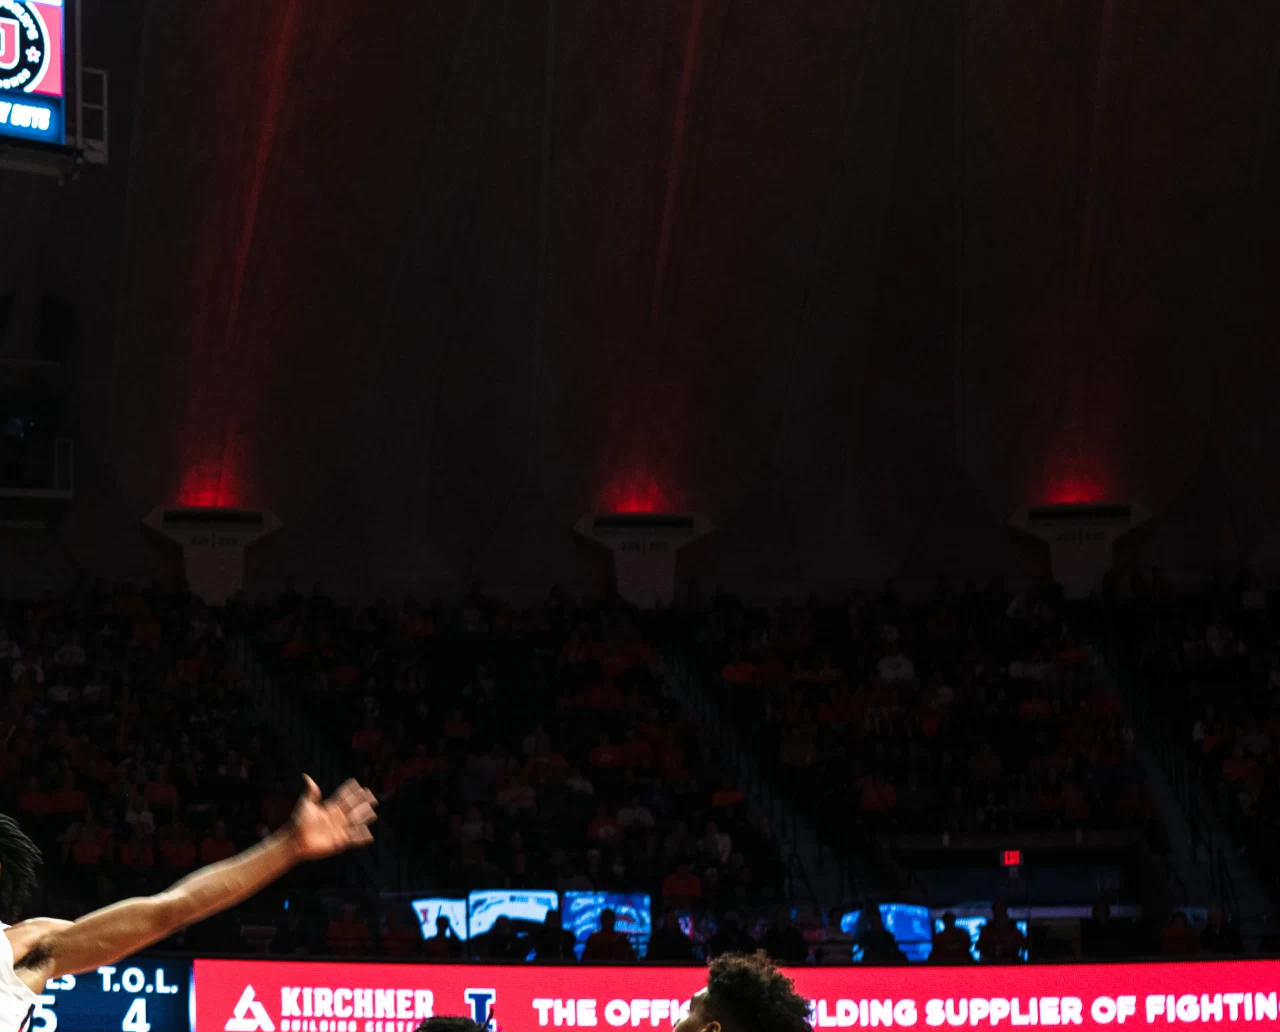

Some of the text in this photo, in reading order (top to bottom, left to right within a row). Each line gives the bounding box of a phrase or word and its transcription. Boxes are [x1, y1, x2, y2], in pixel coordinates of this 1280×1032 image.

[97, 965, 179, 994] T.O.L.
[280, 986, 434, 1019] KIRCHNER
[532, 998, 598, 1027] THE
[925, 995, 1083, 1027] SUPPLIER
[1091, 995, 1136, 1024] OF
[1145, 991, 1280, 1024] FIGHTIN
